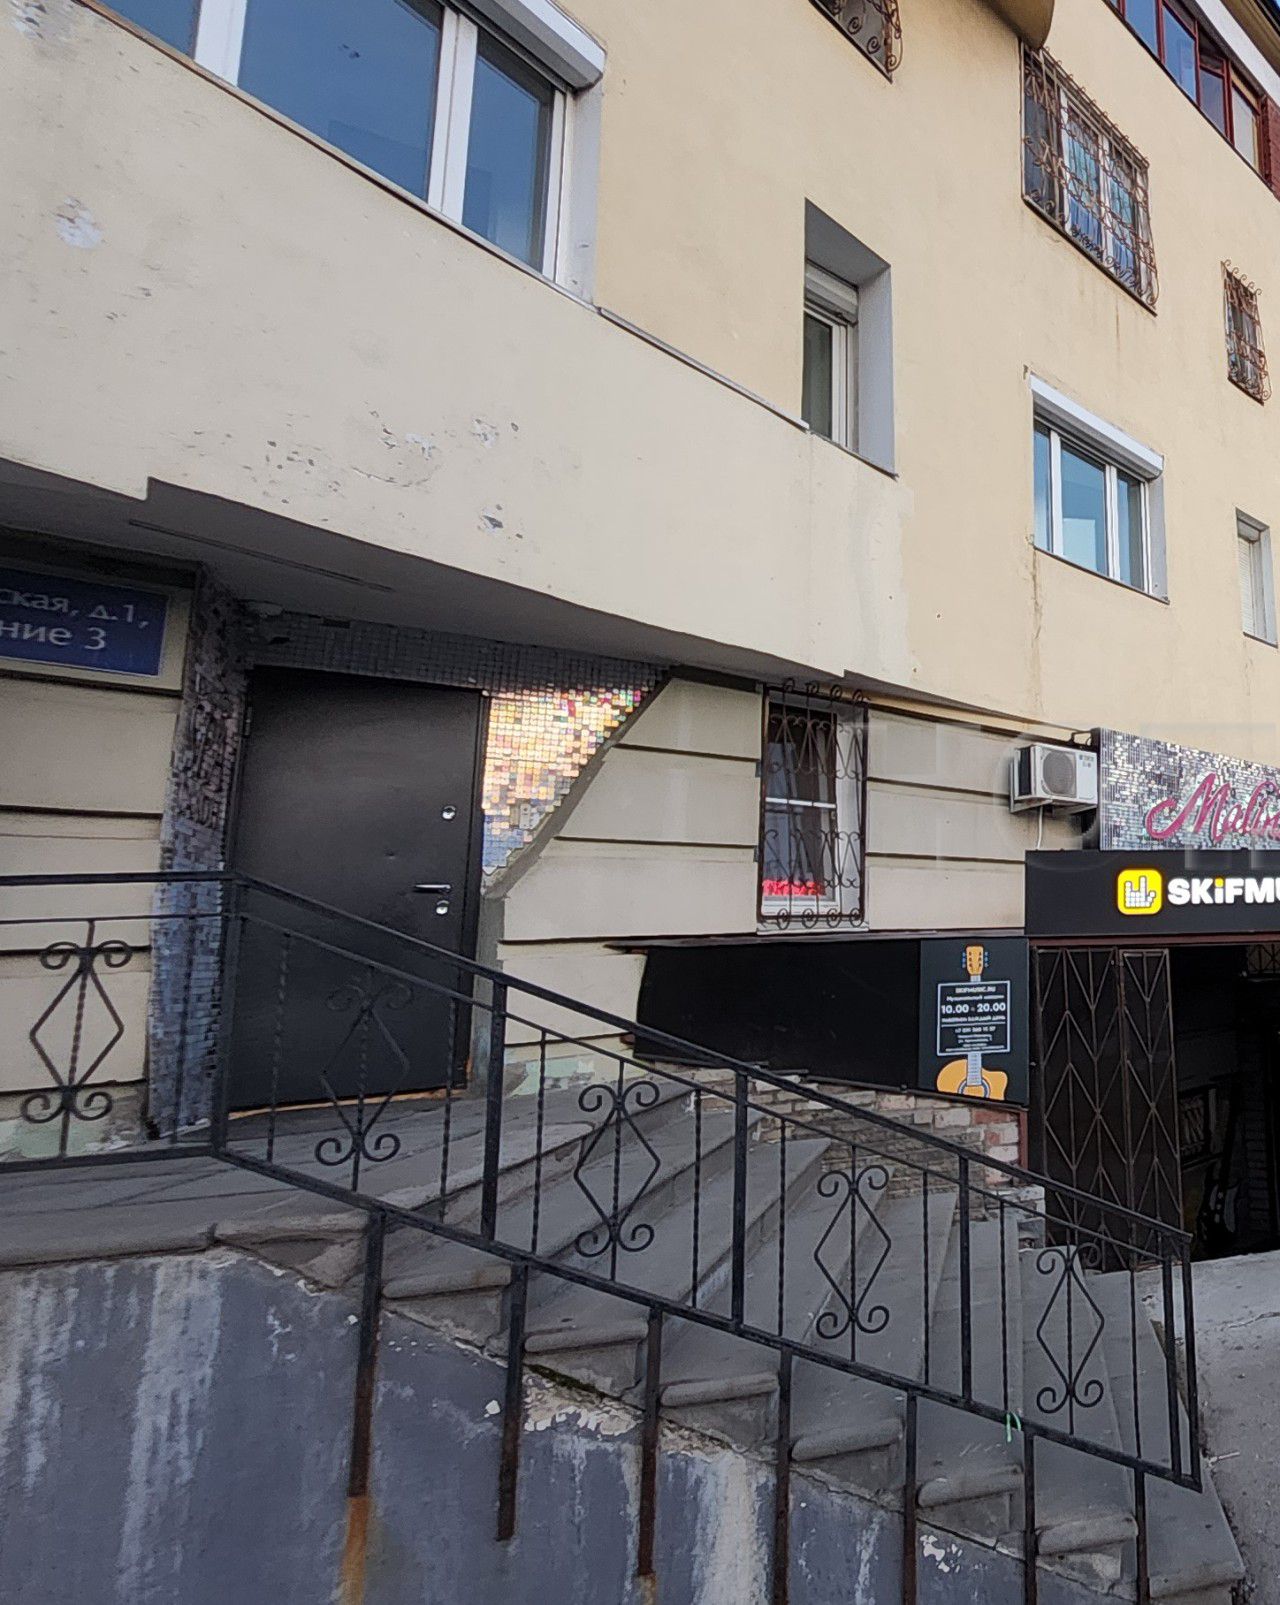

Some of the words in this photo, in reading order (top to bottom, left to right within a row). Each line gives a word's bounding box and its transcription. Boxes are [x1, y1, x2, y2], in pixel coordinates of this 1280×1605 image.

[84, 626, 106, 650] 3
[941, 1004, 969, 1014] 10.00
[976, 1002, 1006, 1012] 20.00
